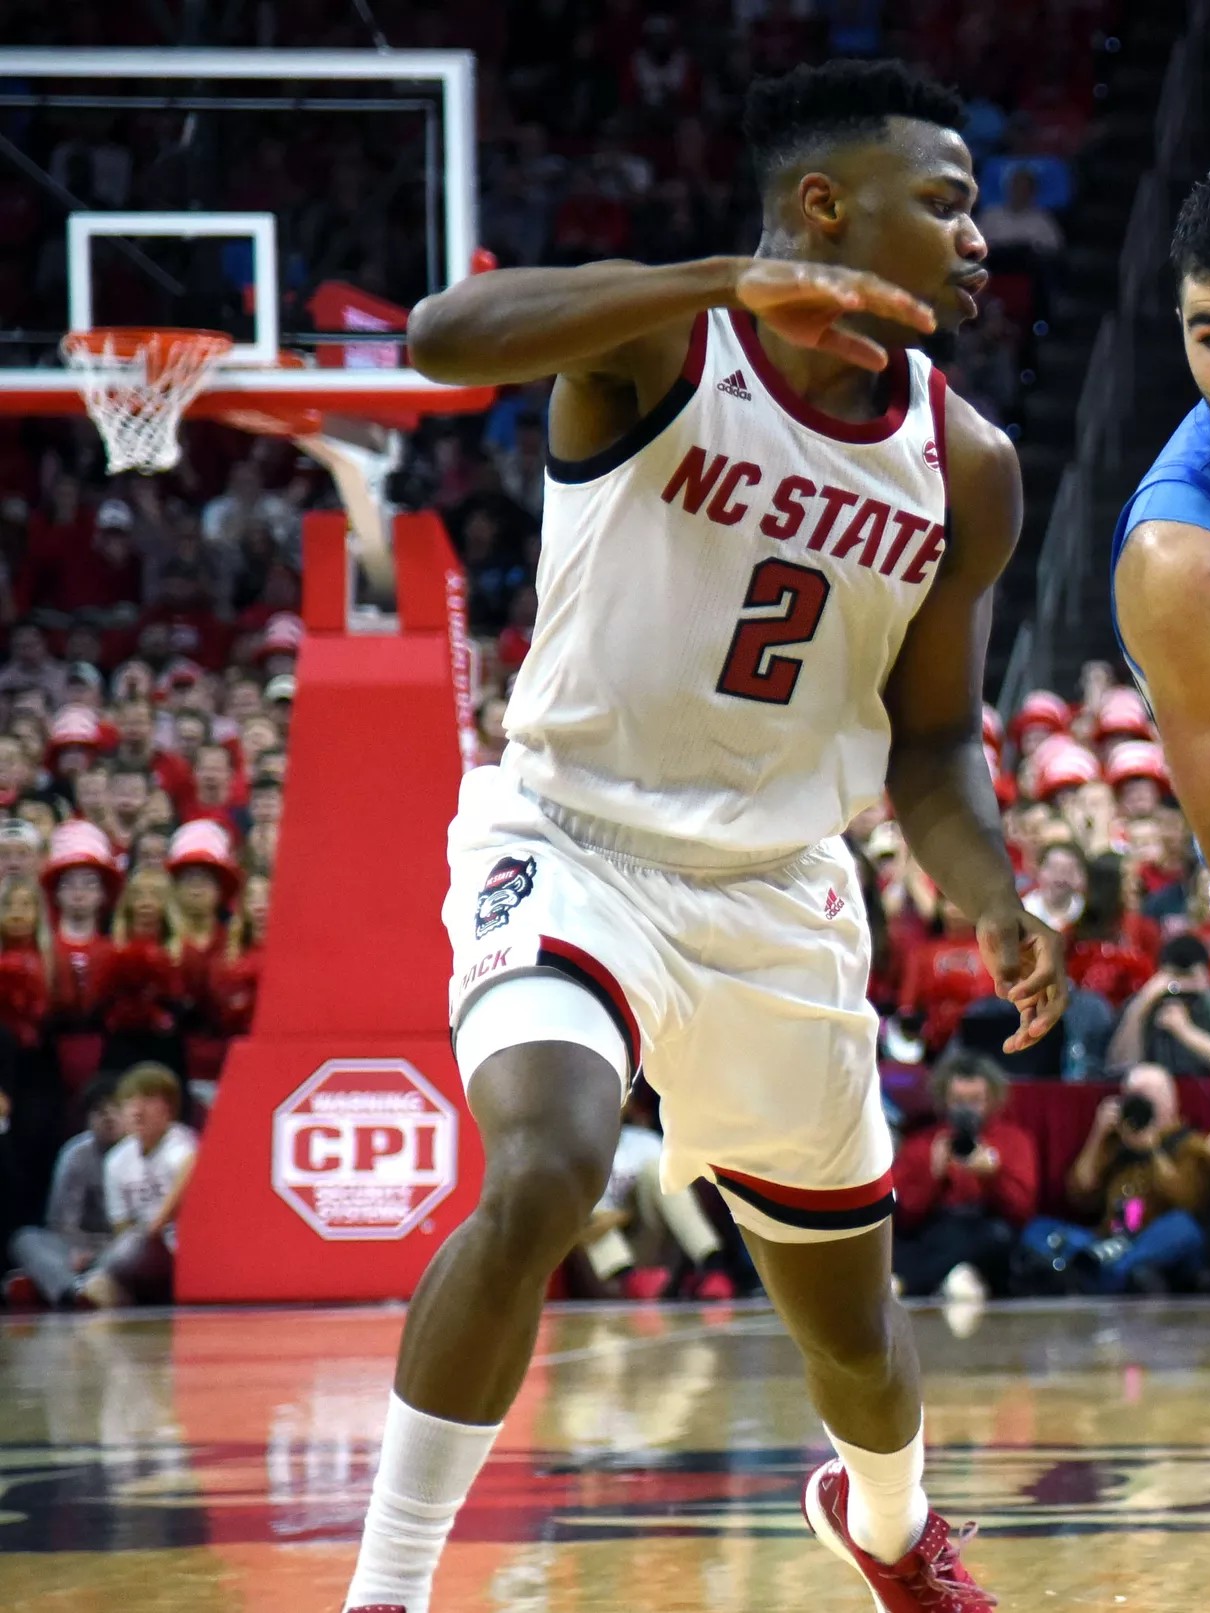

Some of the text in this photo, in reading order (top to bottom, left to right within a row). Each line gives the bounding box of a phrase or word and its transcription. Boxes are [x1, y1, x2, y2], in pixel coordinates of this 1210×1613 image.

[717, 382, 752, 402] adidas
[661, 445, 946, 584] NC STATE
[716, 556, 831, 705] 2
[293, 1125, 436, 1173] CPI
